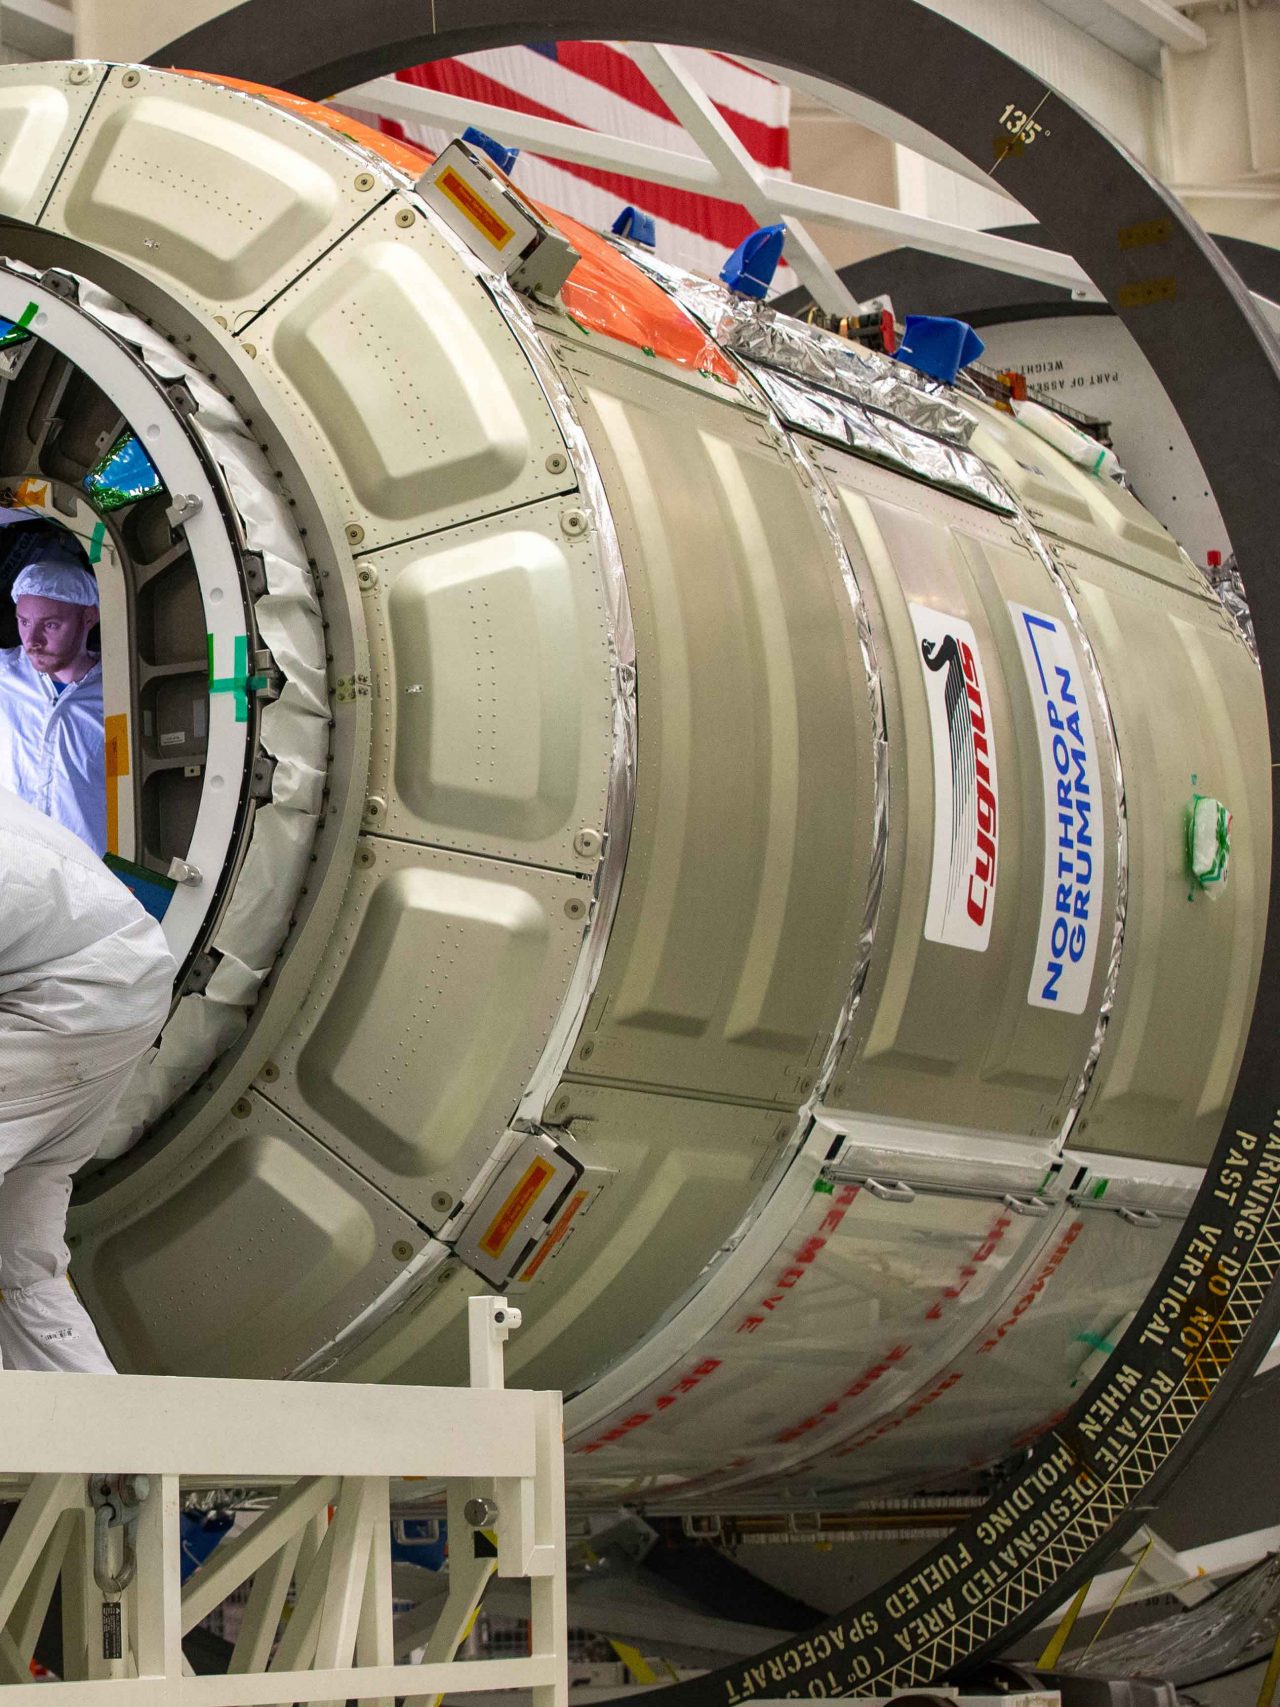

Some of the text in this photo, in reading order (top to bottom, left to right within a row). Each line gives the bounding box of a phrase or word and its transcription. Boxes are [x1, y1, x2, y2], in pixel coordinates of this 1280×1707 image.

[1070, 377, 1085, 388] OF
[1089, 371, 1119, 386] PART
[957, 637, 997, 927] Cygnus
[1054, 665, 1093, 963] GRUMMAN
[1041, 699, 1075, 1002] NORTHROP
[1214, 1130, 1258, 1207] PAST
[735, 1184, 861, 1334] REMOVE
[976, 1221, 1084, 1354] REMOVE
[1139, 1223, 1222, 1346] VERTICAL
[1171, 1306, 1215, 1367] NOT
[1078, 1364, 1143, 1441] WHEN
[1094, 1370, 1176, 1473] ROTATE
[961, 1471, 1098, 1605] DESIGNATED
[976, 1445, 1075, 1546] HOLDING
[885, 1542, 973, 1619] FUELED
[893, 1596, 957, 1652] AREA
[724, 1611, 879, 1704] SPACECRAFT
